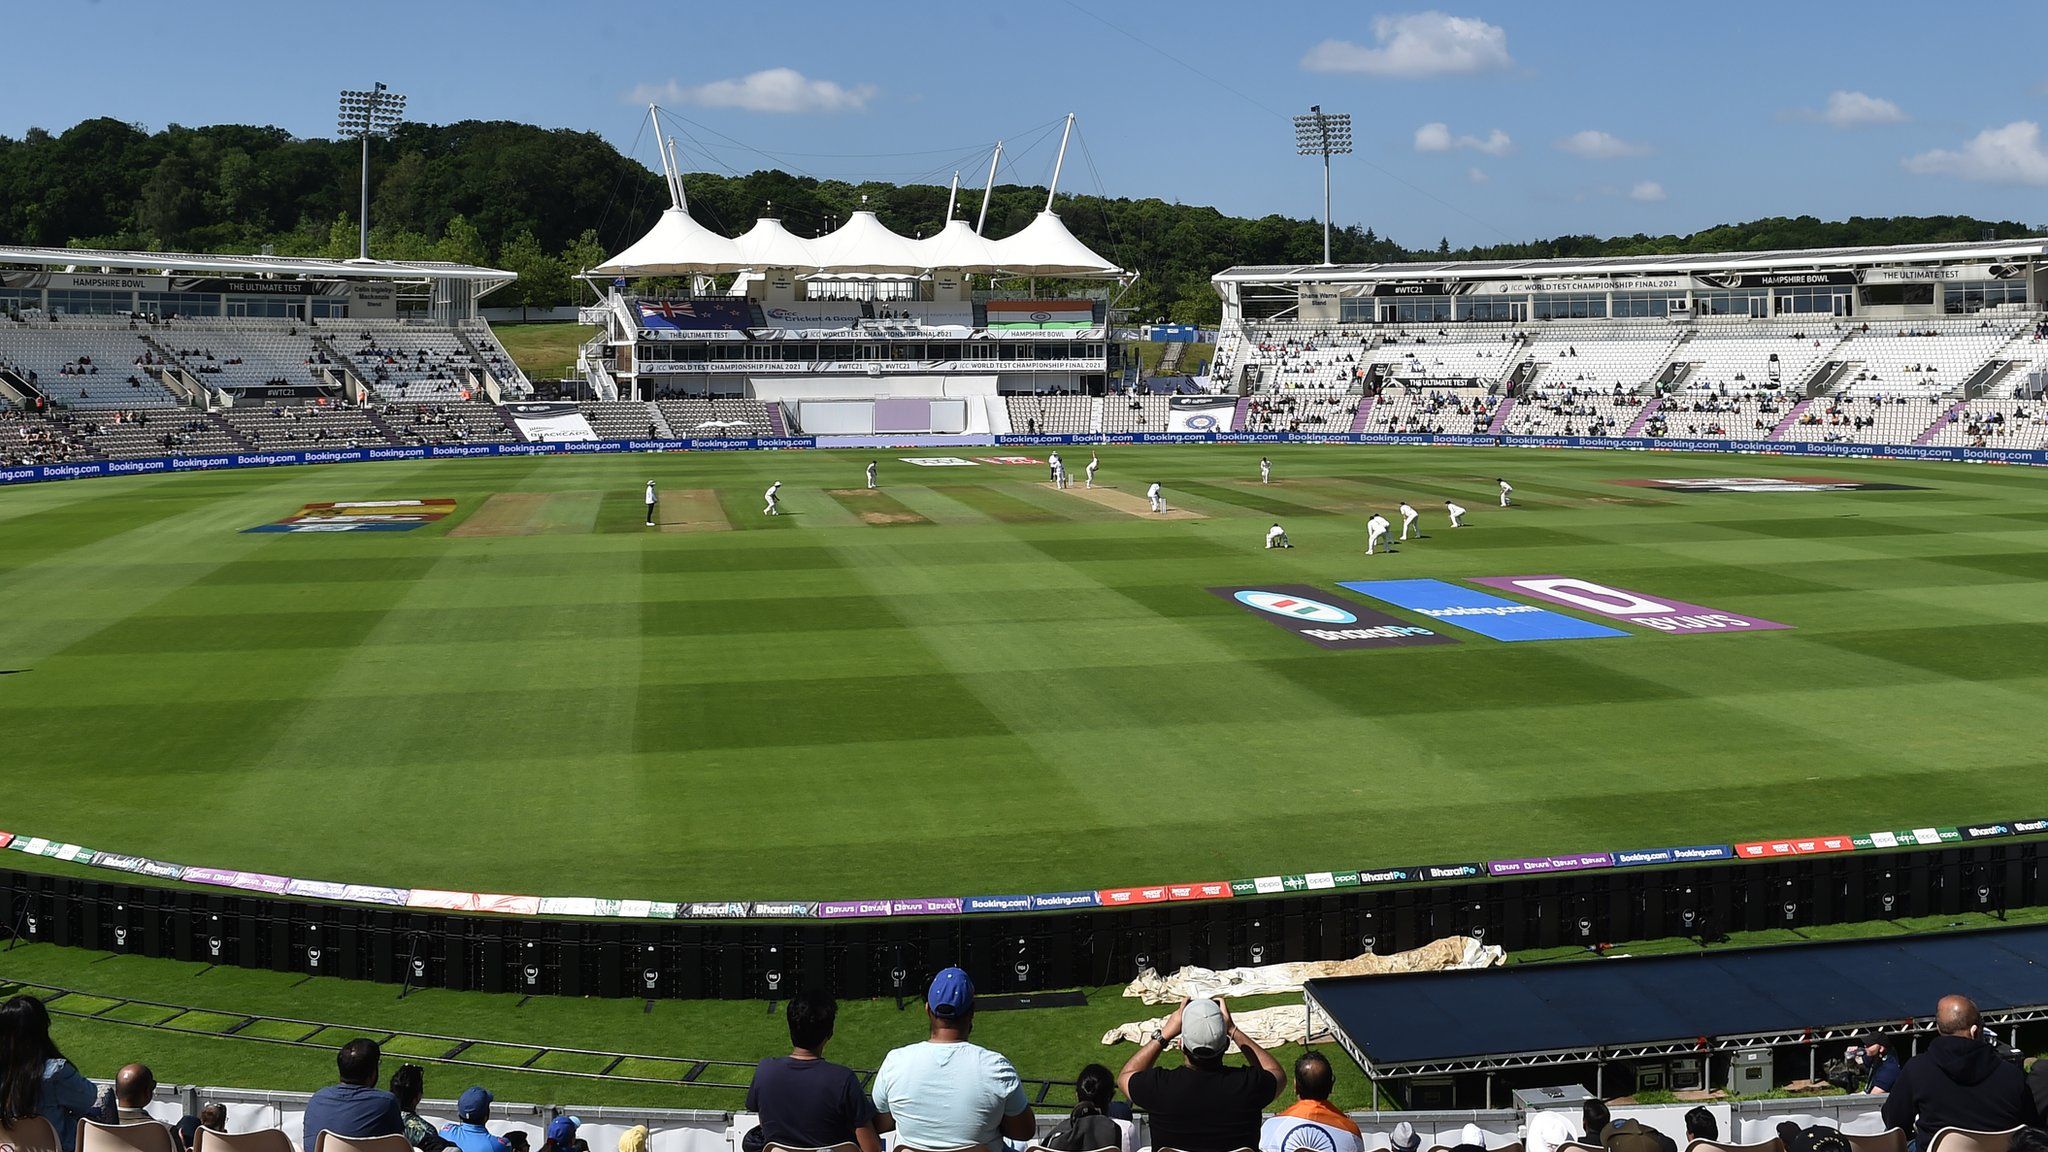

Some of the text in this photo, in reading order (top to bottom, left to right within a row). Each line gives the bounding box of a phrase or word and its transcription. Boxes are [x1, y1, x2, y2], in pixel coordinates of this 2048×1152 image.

[1899, 271, 1939, 279] ULTIMATE
[1942, 270, 1959, 278] TEST
[73, 278, 146, 288] HAMPSHIRE BOWL
[1762, 276, 1805, 284] HAMPSHIRE
[229, 283, 302, 293] THE ULTIMATE TEST
[1395, 286, 1423, 294] #WTC21
[1553, 282, 1570, 290] TEST
[1572, 281, 1633, 290] CHAMPIONSHIP
[822, 330, 846, 338] WORLD
[846, 330, 862, 338] TEST
[863, 330, 915, 338] CHAMPIONSHIP
[916, 330, 935, 338] FINAL
[936, 330, 952, 338] 2021
[268, 388, 296, 397] #WTC21
[758, 437, 812, 448] Booking.com
[1000, 434, 1062, 444] Booking.com
[1072, 434, 1134, 443] Booking.com
[1144, 433, 1206, 442] Booking.com
[1216, 433, 1278, 442] Booking.com
[1288, 434, 1350, 444] Booking.com
[1360, 434, 1422, 444] Booking.com
[1433, 435, 1495, 444] Booking.com
[1506, 436, 1569, 446] Booking.com
[564, 442, 621, 453] Booking.com
[692, 438, 748, 450] Booking.com
[1579, 438, 1643, 448] Booking.com
[1654, 440, 1720, 450] Booking.com
[1730, 442, 1796, 452] Booking.com
[370, 448, 424, 460] Booking.com
[433, 446, 490, 457] Booking.com
[498, 444, 556, 454] Booking.com
[1807, 444, 1874, 454] Booking.com
[1884, 446, 1952, 458] Booking.com
[1963, 448, 2032, 460] Booking.com
[238, 454, 296, 466] Booking.com
[305, 451, 361, 463] Booking.com
[109, 460, 164, 473] Booking.com
[172, 457, 229, 470] Booking.com
[0, 468, 34, 481] ing.com
[44, 464, 100, 478] Booking.com
[1300, 625, 1435, 641] BharatPe
[1940, 831, 1958, 839] oppo
[1969, 824, 2008, 837] BharatPe
[1853, 838, 1872, 846] oppo
[1620, 852, 1668, 862] Booking.com
[1674, 848, 1723, 858] Booking.com
[1362, 870, 1406, 883] BharatPe
[1430, 866, 1476, 878] BharatPe
[1284, 879, 1306, 888] oppo
[1308, 876, 1331, 886] oppo
[1334, 874, 1357, 883] oppo
[1258, 880, 1280, 889] oppo
[972, 900, 1028, 910] Booking.com
[1036, 895, 1091, 906] Booking.com
[692, 904, 743, 914] BharatPe
[756, 904, 807, 914] BharatPe
